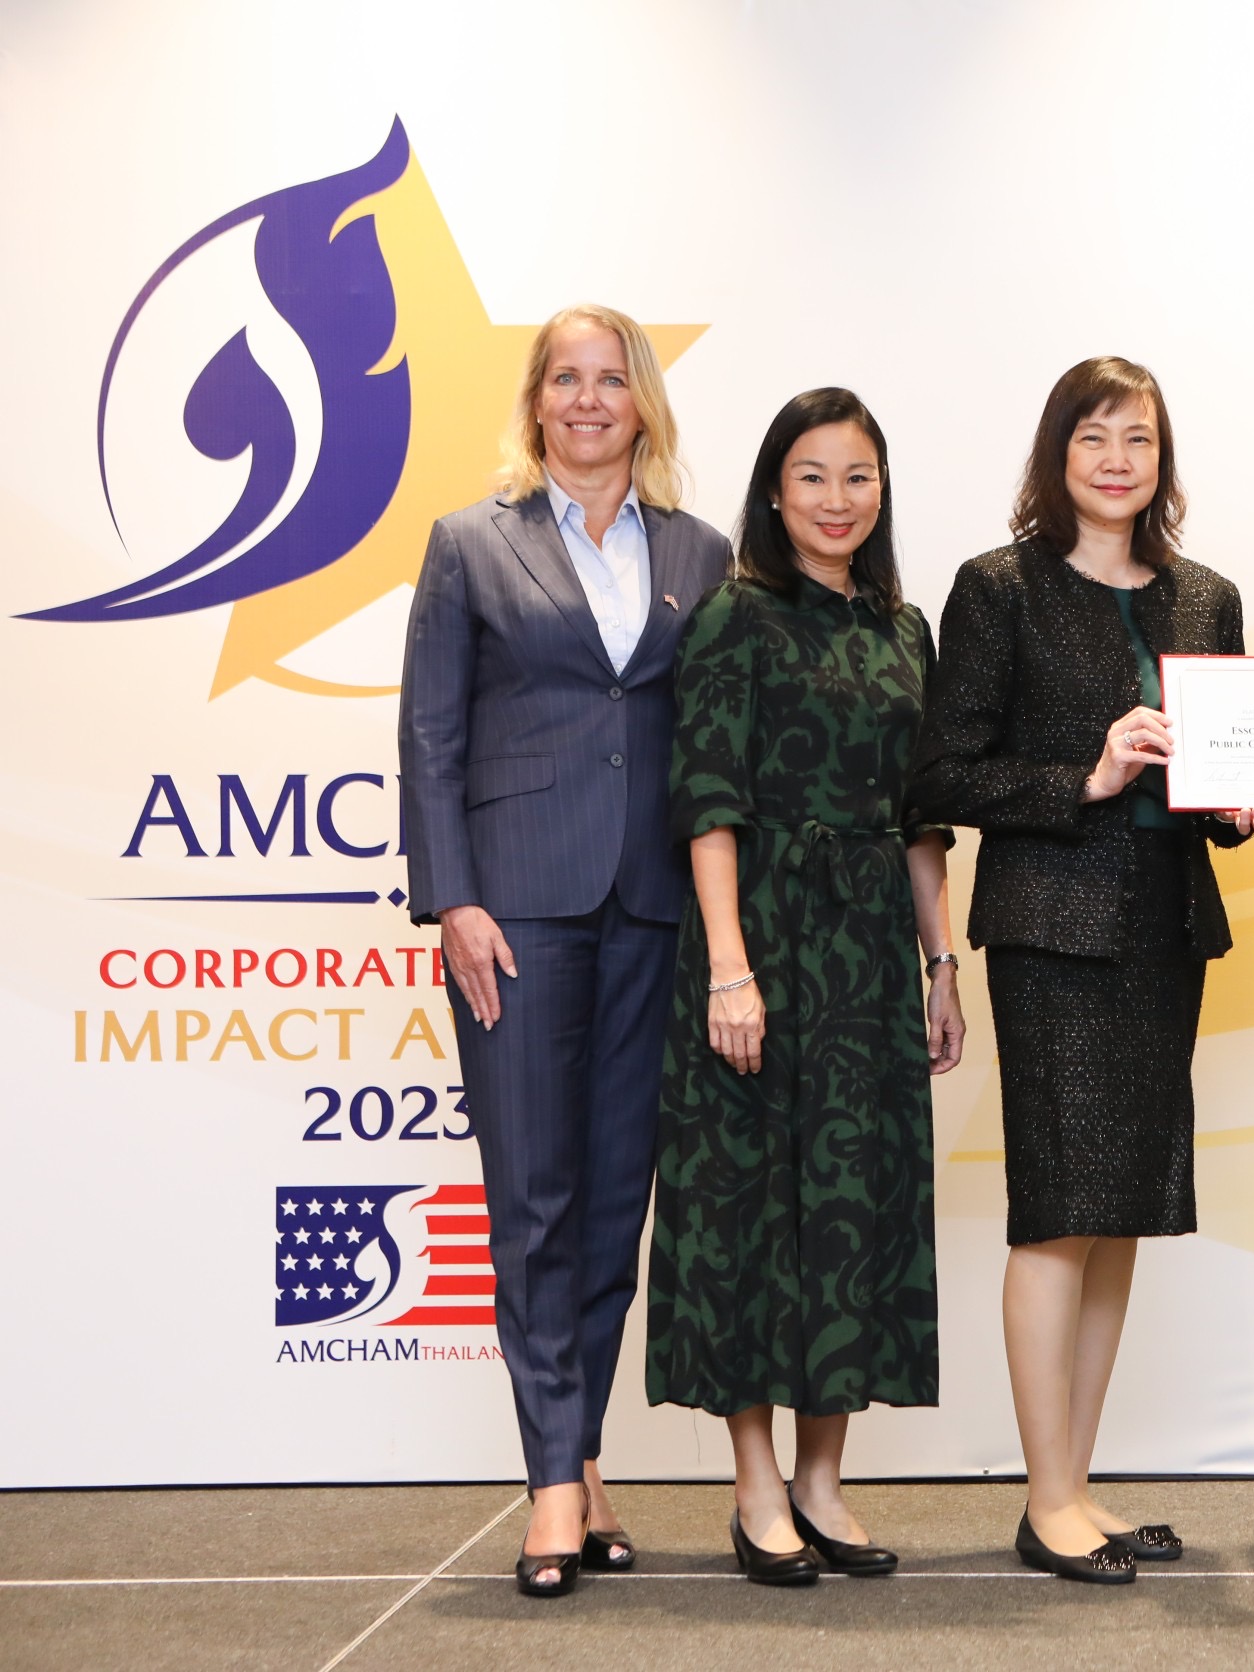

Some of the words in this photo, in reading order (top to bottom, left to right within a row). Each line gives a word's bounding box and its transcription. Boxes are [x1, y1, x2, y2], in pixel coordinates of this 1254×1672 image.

[119, 772, 408, 858] AMC
[74, 1008, 365, 1062] IMPACT
[302, 1085, 477, 1141] 2023
